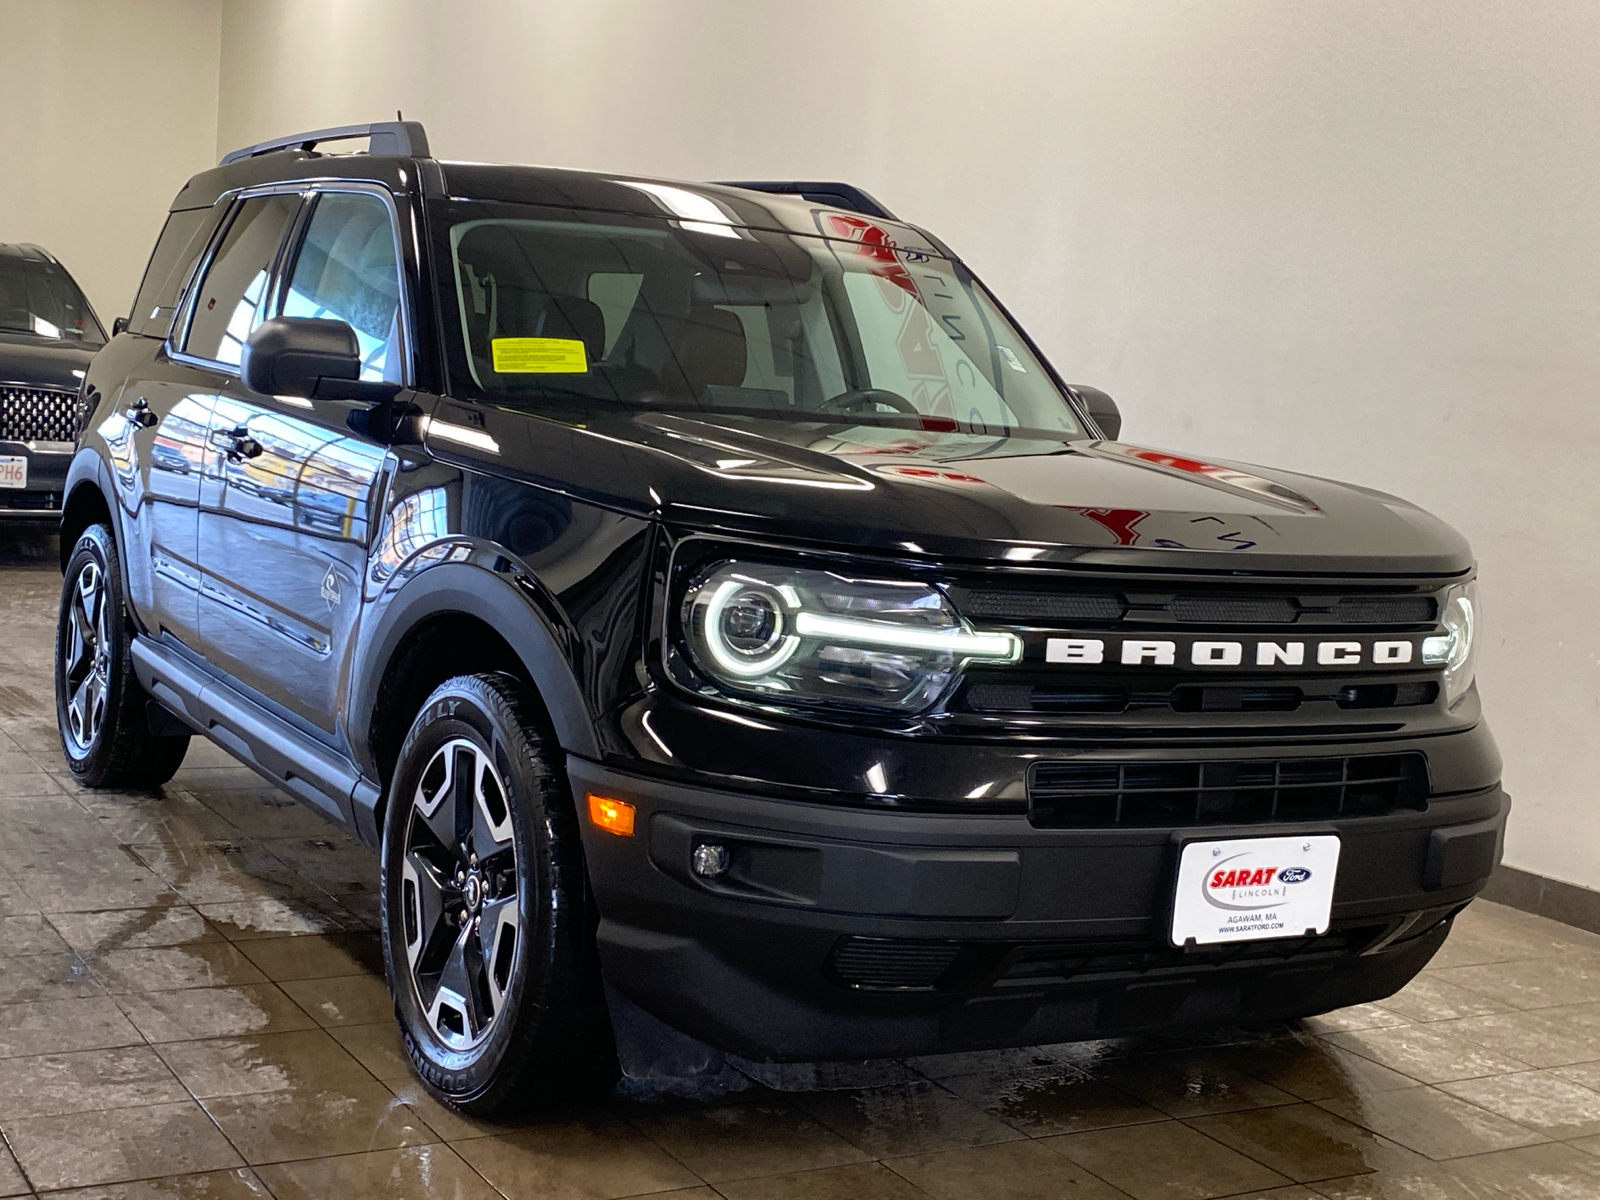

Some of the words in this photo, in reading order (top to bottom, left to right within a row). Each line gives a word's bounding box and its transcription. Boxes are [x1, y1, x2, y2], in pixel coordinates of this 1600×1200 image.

[1046, 638, 1413, 666] BRONCO
[404, 700, 461, 759] KELLY
[1211, 867, 1278, 888] SARAT
[1280, 867, 1309, 883] Ford
[1238, 888, 1280, 898] LINCOLN
[1227, 914, 1263, 924] AGAWAM,
[1265, 913, 1277, 921] MA
[1219, 922, 1284, 933] WWW.SARATFORD.COM
